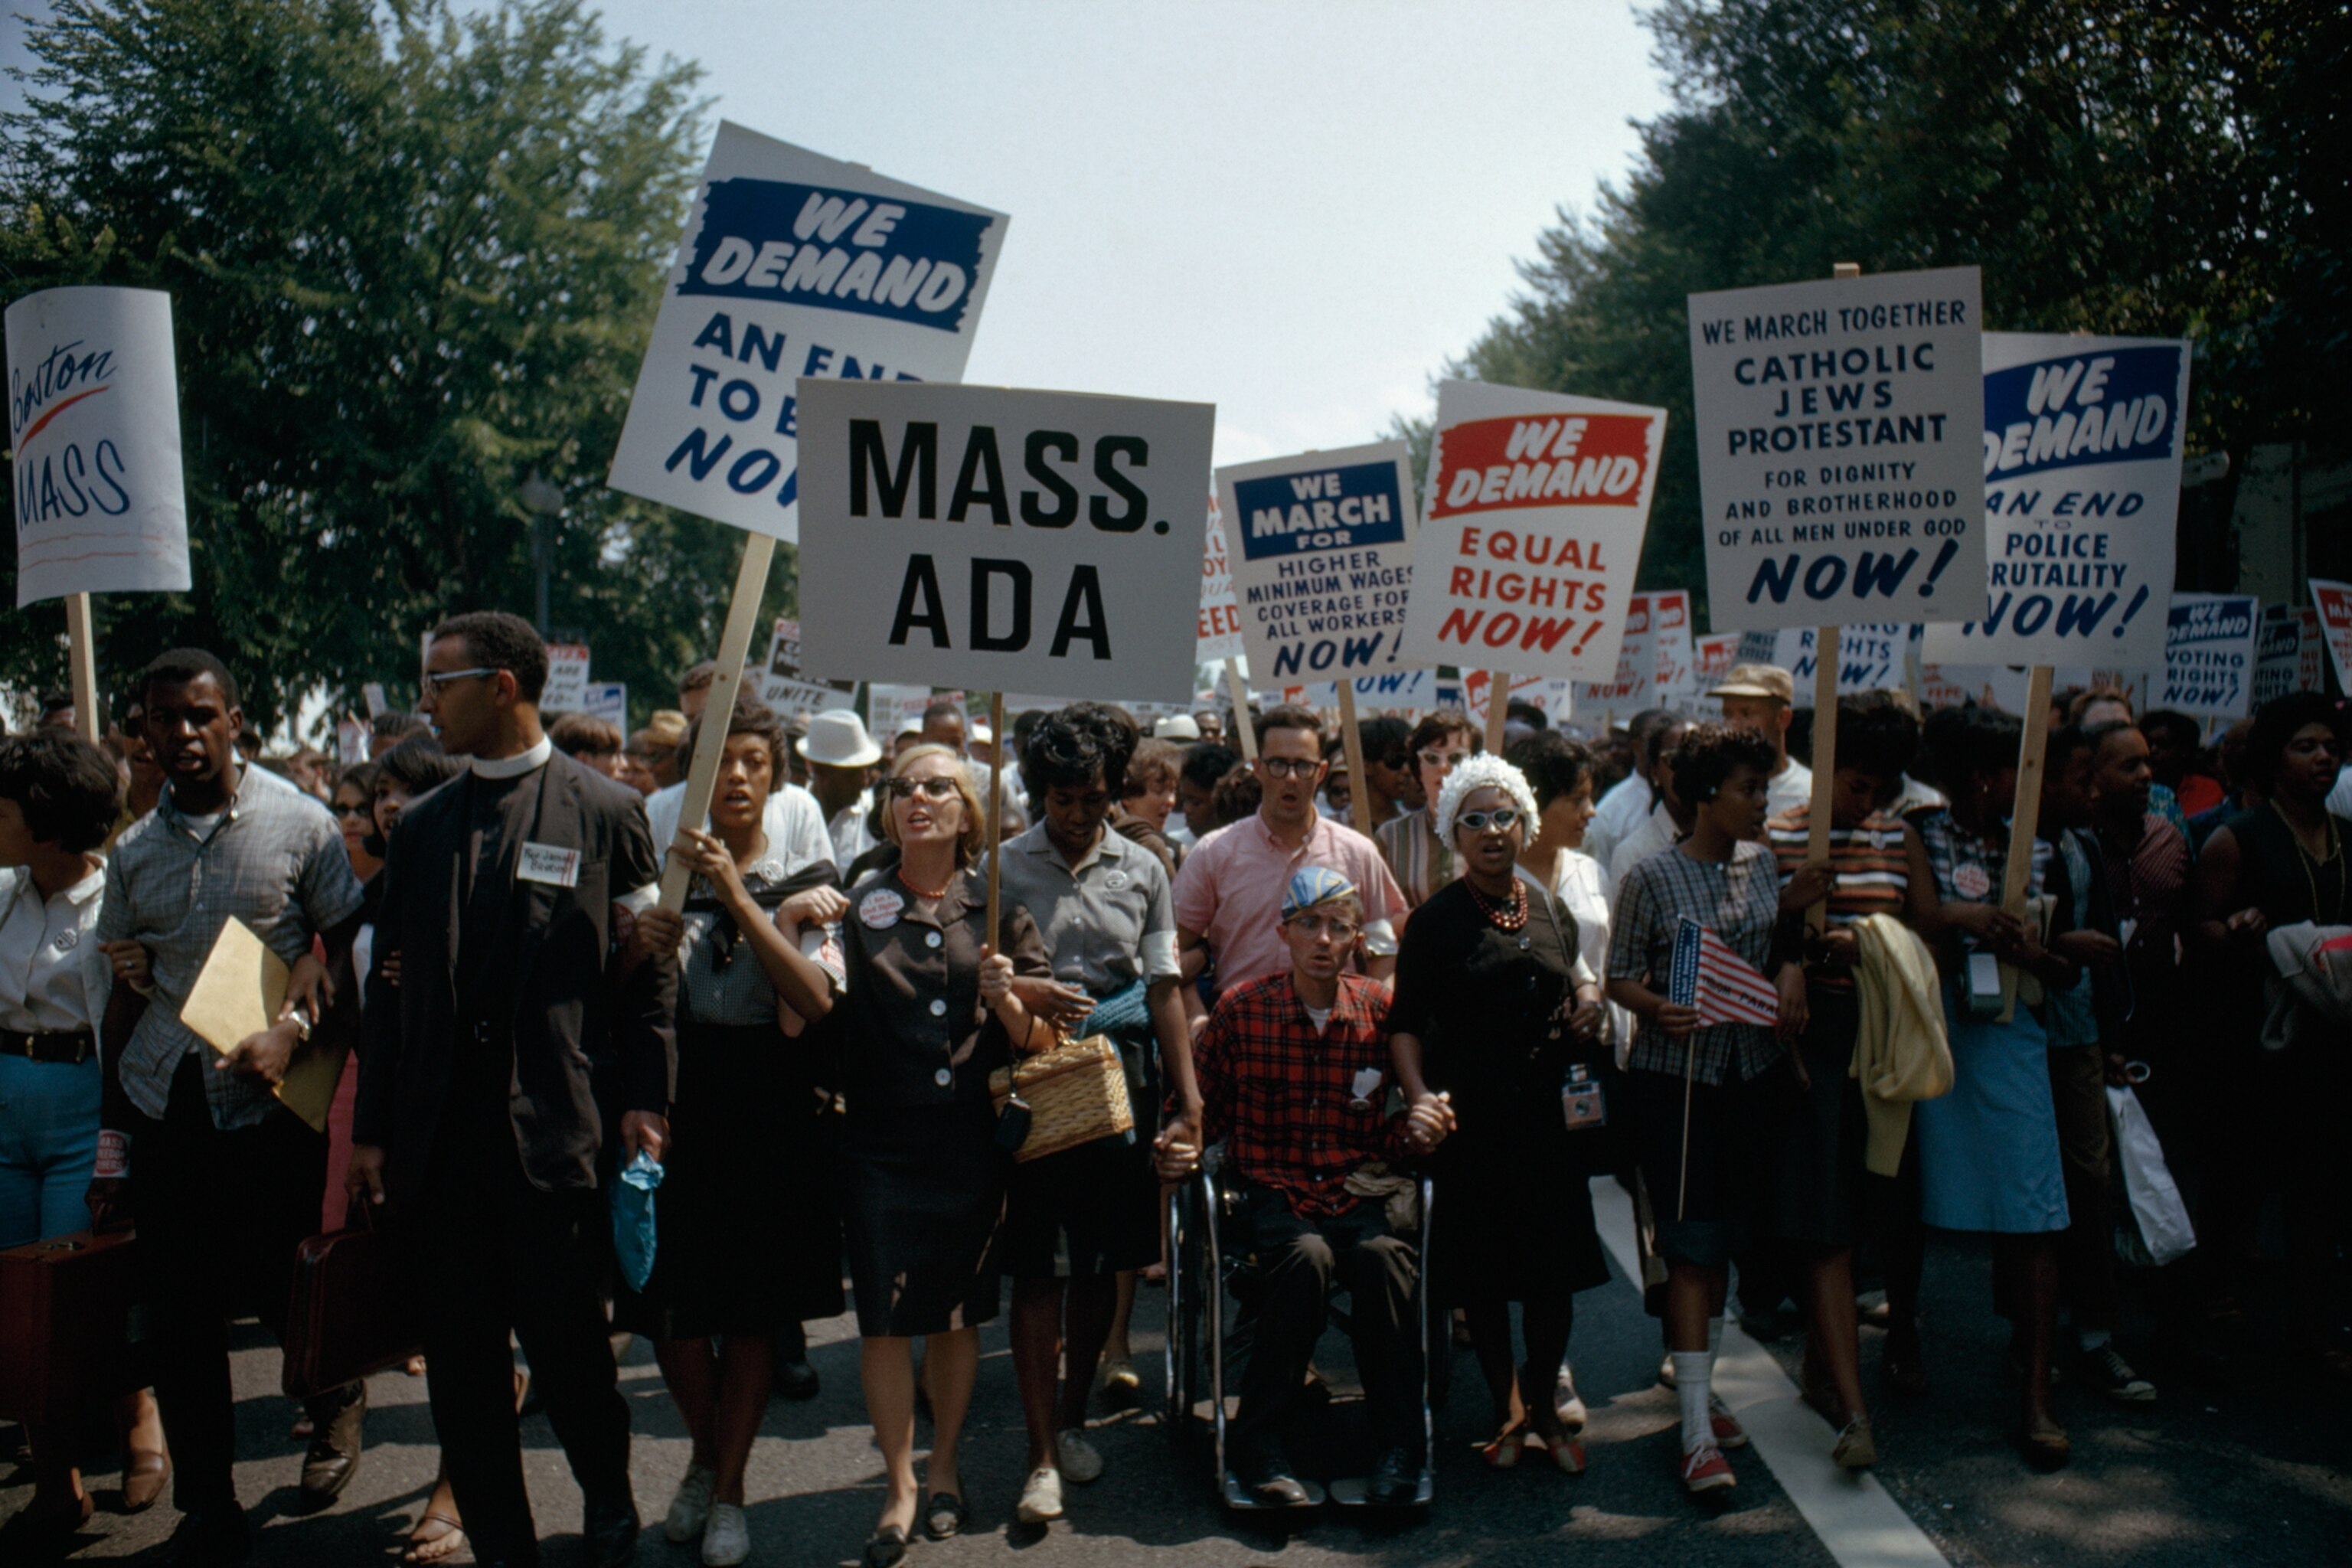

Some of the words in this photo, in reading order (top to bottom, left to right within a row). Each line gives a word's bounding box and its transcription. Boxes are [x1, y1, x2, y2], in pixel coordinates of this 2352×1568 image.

[792, 191, 906, 248] WE
[701, 236, 967, 312] DEMAND
[1703, 320, 1735, 345] WE
[1745, 309, 1828, 342] MARCH
[1839, 299, 1966, 332] TOGETHER
[693, 312, 787, 372] AN
[803, 343, 923, 381] EN
[1734, 342, 1935, 384] CATHOLIC
[13, 339, 117, 434] Boston
[689, 364, 761, 423] TO
[1774, 381, 1893, 417] JEWS
[2027, 357, 2115, 416] WE
[1505, 418, 1588, 461] WE
[1728, 413, 1947, 456] PROTESTANT
[1984, 394, 2167, 475] DEMAND
[18, 439, 130, 531] MASS
[665, 427, 797, 508] NO
[849, 419, 1170, 536] MASS.
[1291, 472, 1342, 501] WE
[1446, 455, 1639, 508] DEMAND
[1765, 470, 1807, 488] FOR
[1820, 462, 1917, 484] DIGNITY
[1251, 494, 1390, 538] MARCH
[1726, 501, 1771, 520] AND
[1788, 489, 1957, 516] BROTHERHOOD
[1985, 490, 2041, 516] AN
[2053, 491, 2145, 518] END
[1296, 531, 1352, 550] FOR
[1719, 530, 1741, 547] OF
[1751, 528, 1784, 546] ALL
[1793, 523, 1834, 543] MEN
[1844, 520, 1911, 539] UNDER
[1924, 517, 1966, 536] GOD
[2005, 534, 2109, 559] POLICE
[2034, 520, 2072, 531] TO
[1278, 551, 1380, 578] HIGHER
[1459, 527, 1606, 572] EQUAL
[1746, 537, 1958, 604] NOW!
[1246, 576, 1341, 604] MINIMUM
[1449, 566, 1606, 612] RIGHTS
[1990, 564, 2128, 587] RUTALITY
[888, 553, 1112, 661] ADA
[1257, 595, 1363, 622] COVERAGE
[1266, 621, 1300, 640] ALL
[1308, 608, 1406, 633] WORKERS
[1962, 583, 2149, 639] NOW!
[2189, 603, 2222, 622] WE
[1437, 608, 1604, 656] NOW!
[1801, 631, 1890, 661] RHTS
[2168, 615, 2248, 642] DEMAND
[1273, 628, 1403, 678] NOW!
[1793, 656, 1890, 687] NW!
[2165, 652, 2245, 669] VOTING
[1341, 671, 1423, 694] OW!
[2163, 686, 2239, 707] NOW!
[2167, 668, 2239, 685] RIGHTS
